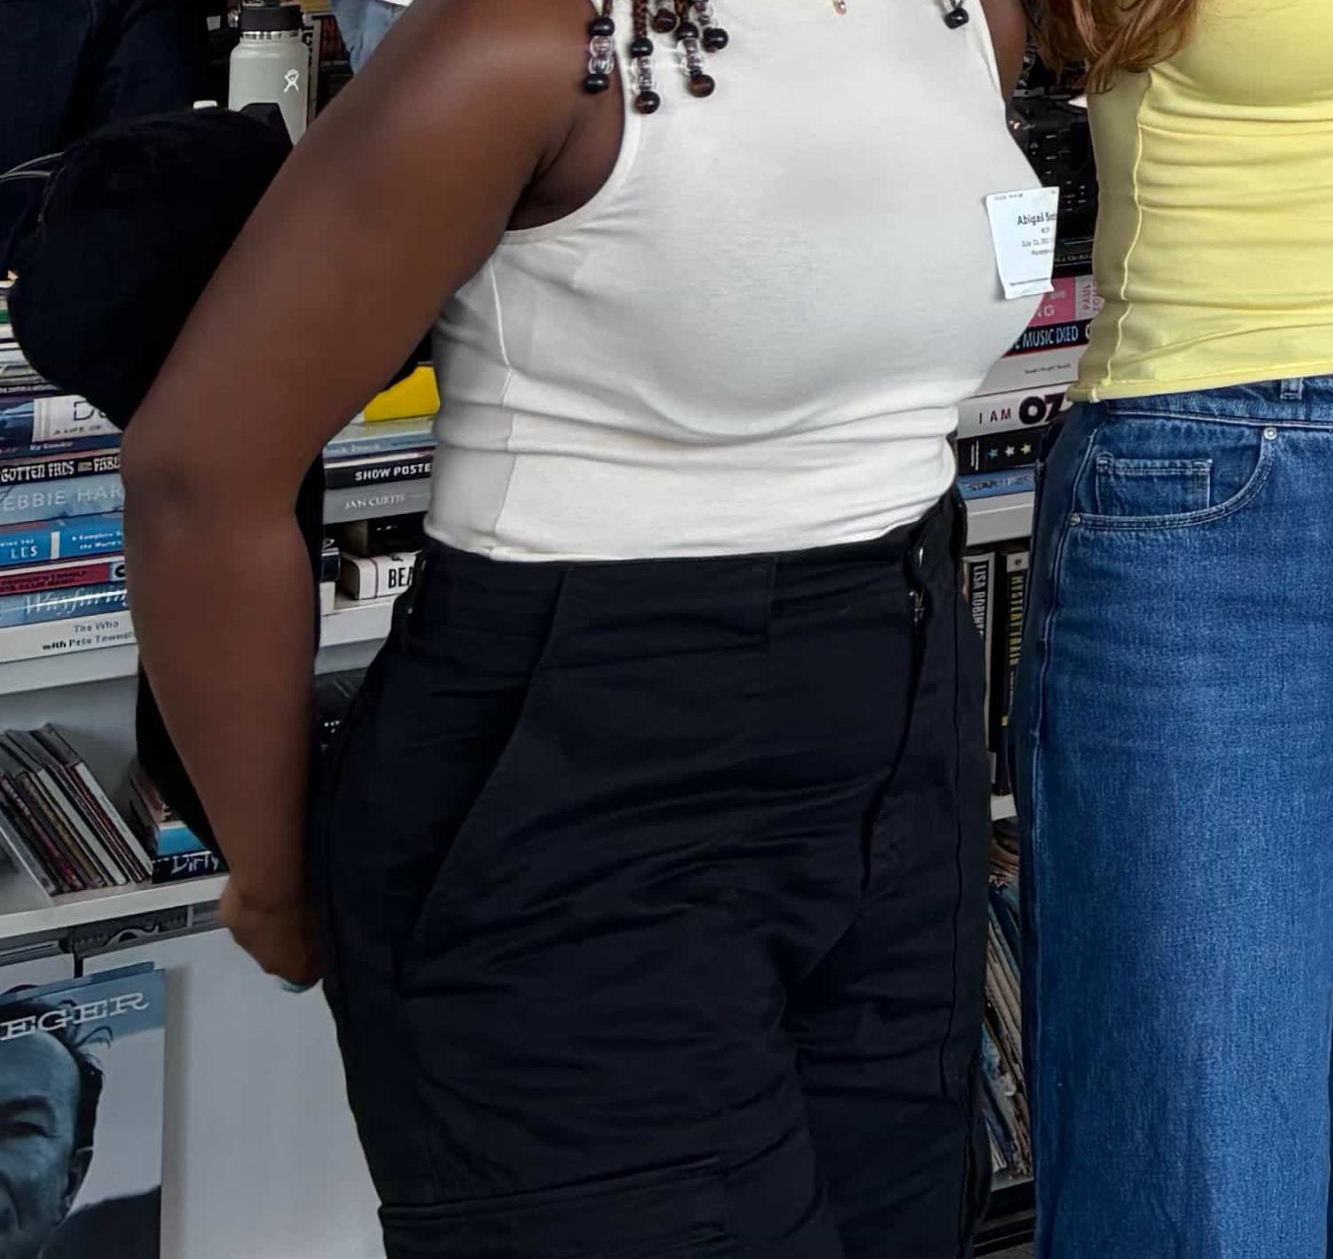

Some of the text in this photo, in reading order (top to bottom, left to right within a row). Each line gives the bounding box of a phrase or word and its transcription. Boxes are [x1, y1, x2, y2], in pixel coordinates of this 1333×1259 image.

[1022, 325, 1079, 349] MUSIC DIED
[990, 407, 1012, 422] AM
[355, 466, 391, 482] SHOW
[74, 623, 92, 633] The
[42, 639, 67, 651] with
[0, 992, 149, 1041] EGER
